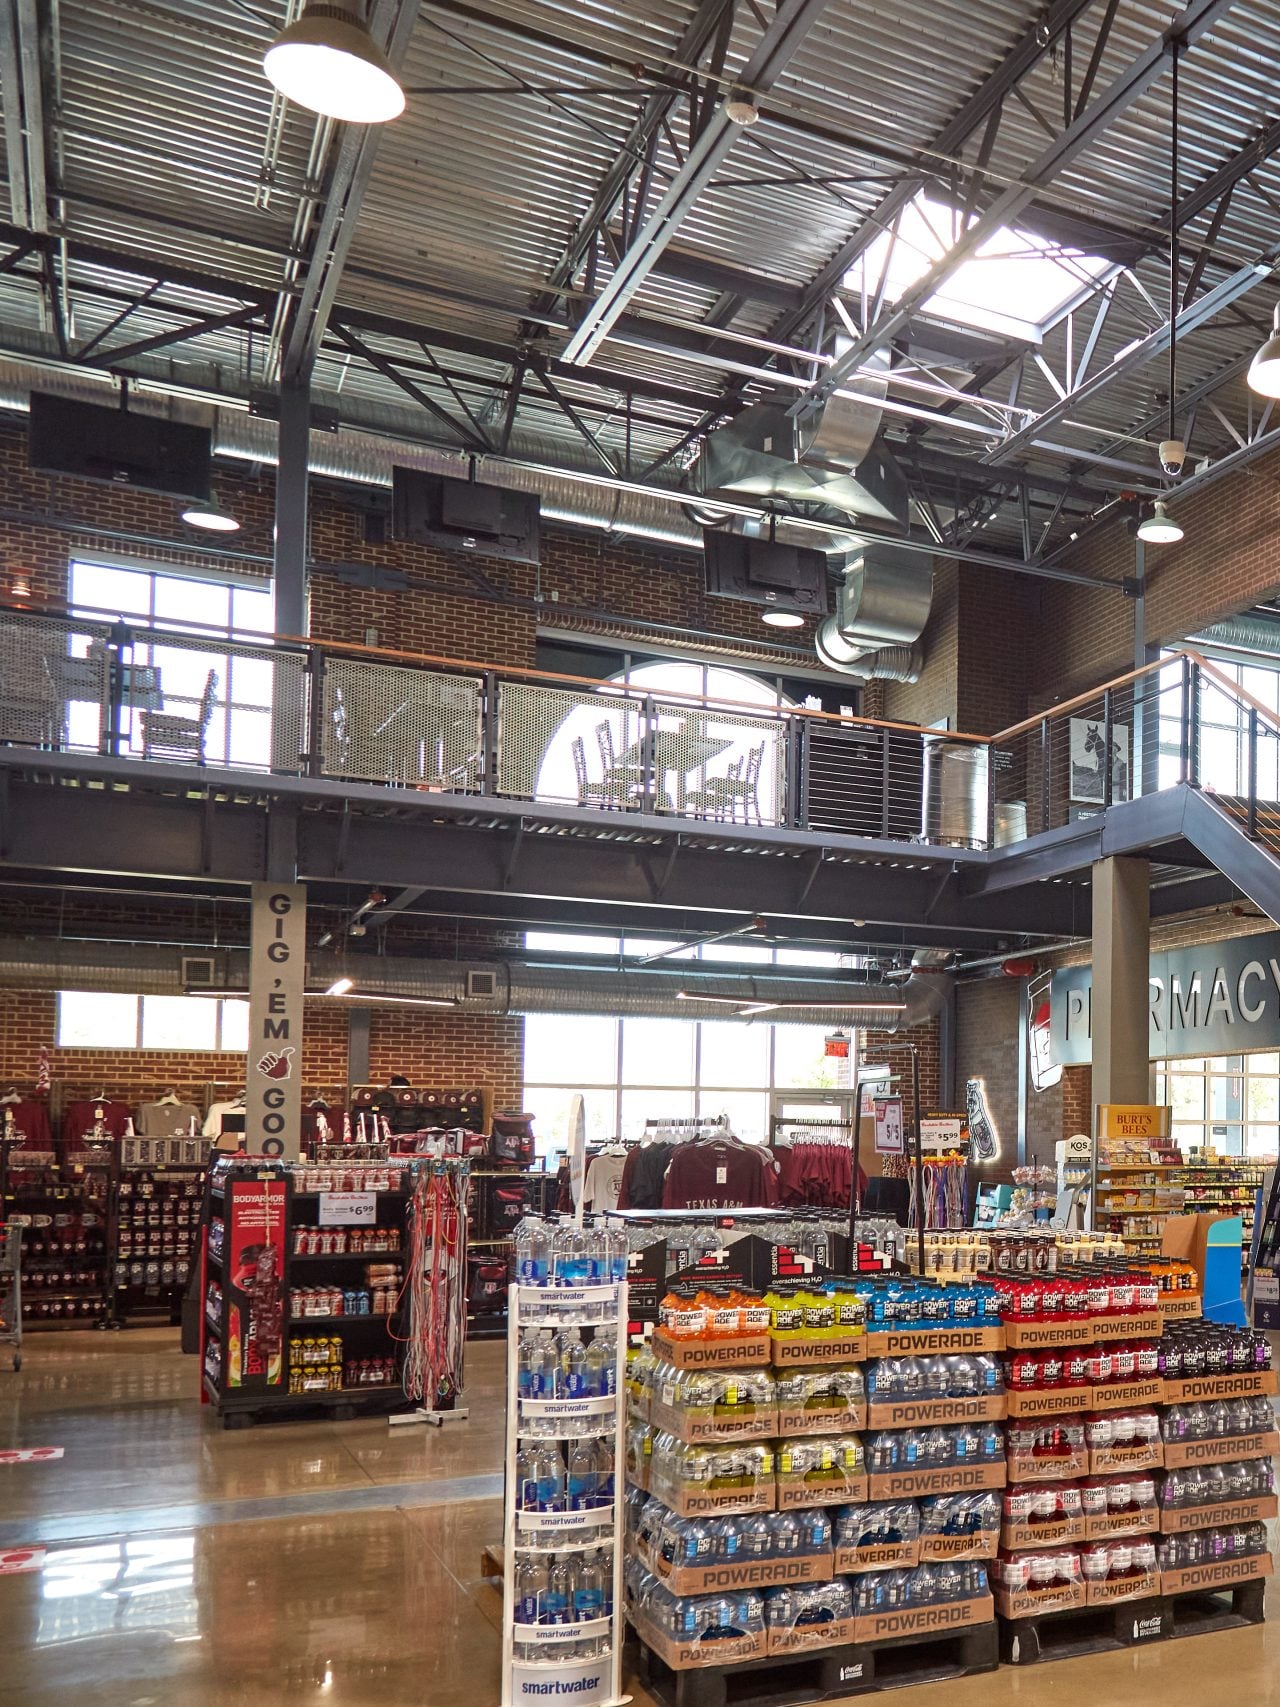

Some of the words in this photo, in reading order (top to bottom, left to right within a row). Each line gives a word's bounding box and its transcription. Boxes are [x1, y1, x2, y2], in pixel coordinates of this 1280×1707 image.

[268, 893, 290, 963] GIG
[1117, 1114, 1152, 1125] BURT'S
[1122, 1125, 1147, 1135] BEES
[1070, 1141, 1088, 1151] KOS
[686, 1199, 718, 1210] TEXAS
[540, 1292, 585, 1301] smartwater
[1021, 1328, 1088, 1342] POWERADE
[1093, 1320, 1158, 1334] POWERADE
[888, 1332, 984, 1350] POWERADE
[684, 1344, 764, 1362] POWERADE
[781, 1343, 859, 1358] POWERADE
[1097, 1384, 1159, 1401] POWERADE
[1183, 1377, 1262, 1397] POWERADE
[544, 1403, 590, 1413] smartwater
[893, 1401, 987, 1422] POWERADE
[1020, 1395, 1087, 1411] POWERADE
[1186, 1437, 1263, 1460] POWERADE
[891, 1471, 985, 1493] POWERADE
[540, 1516, 586, 1526] smartwater
[1180, 1505, 1259, 1528] POWERADE
[704, 1563, 811, 1587] POWERADE
[1182, 1560, 1258, 1585] POWERADE
[876, 1606, 971, 1634] POWERADE
[536, 1628, 581, 1638] smartwater
[522, 1676, 600, 1695] smartwater
